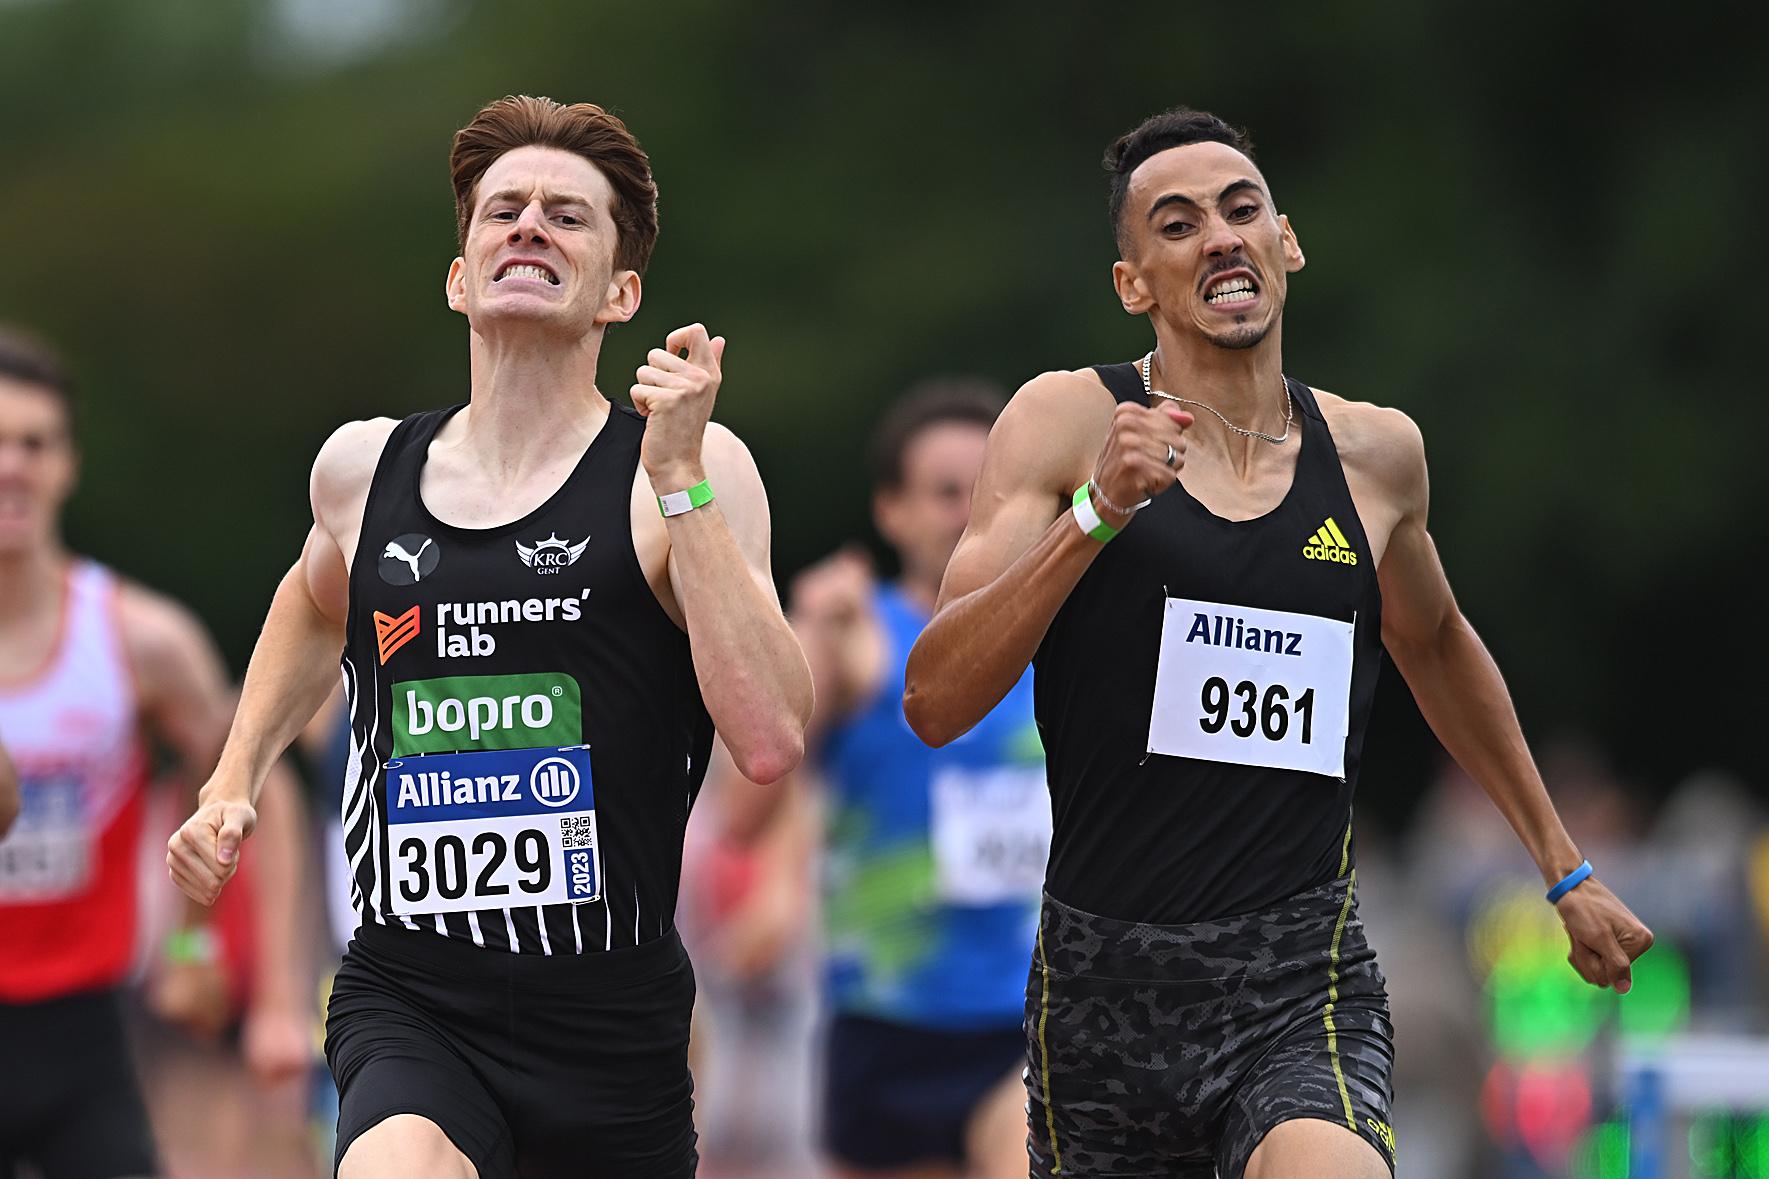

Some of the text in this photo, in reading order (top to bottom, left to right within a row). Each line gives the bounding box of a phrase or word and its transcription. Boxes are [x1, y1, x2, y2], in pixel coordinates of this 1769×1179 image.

[533, 552, 568, 567] KRC
[537, 567, 561, 575] GENT
[1302, 544, 1358, 566] adidas
[437, 626, 496, 658] lab
[1186, 612, 1303, 657] Allianz
[1199, 676, 1315, 745] 9361
[397, 771, 522, 809] Allianz
[398, 828, 551, 903] 3029
[570, 851, 592, 896] 2023
